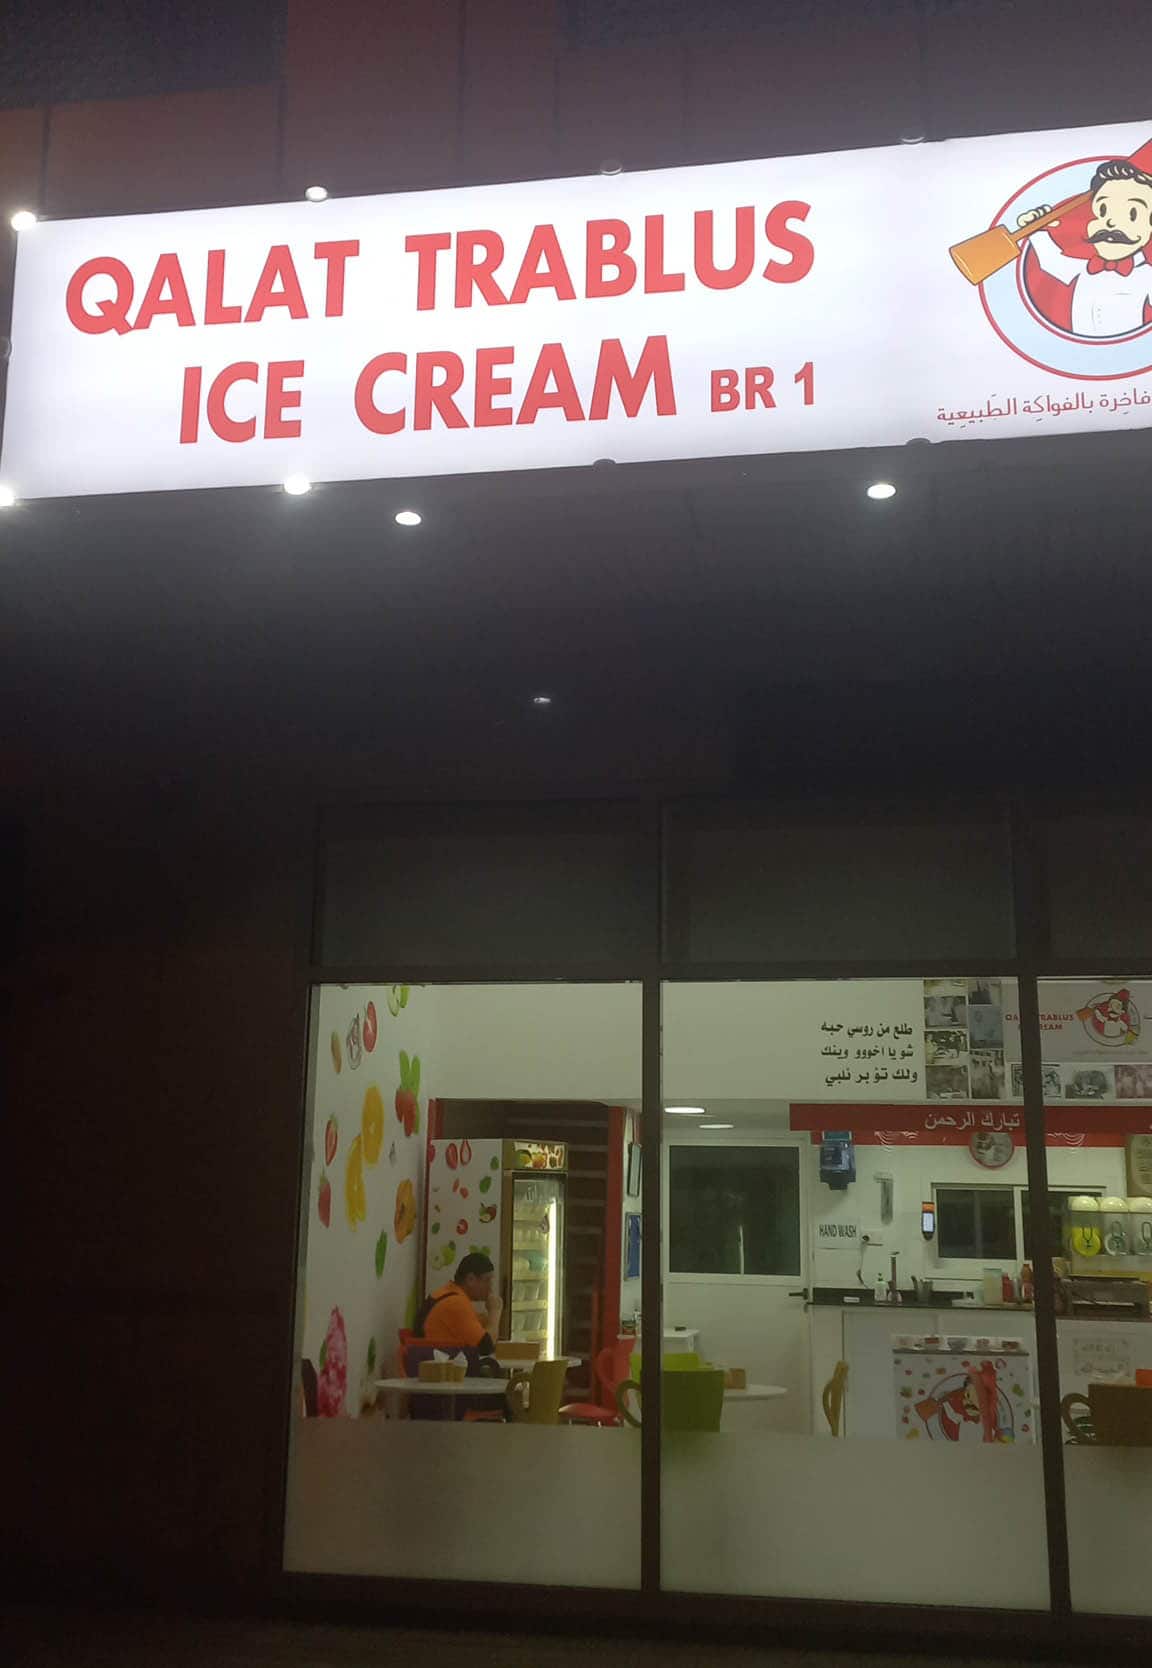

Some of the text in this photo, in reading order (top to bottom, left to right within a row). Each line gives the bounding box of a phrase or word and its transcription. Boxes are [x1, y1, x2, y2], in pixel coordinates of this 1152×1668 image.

[66, 200, 815, 335] QALAT TRABLUS
[179, 335, 814, 444] ICE CREAM BR 1
[847, 1024, 873, 1038] روسي
[876, 1023, 890, 1037] من
[893, 1023, 913, 1040] طلع
[821, 1044, 849, 1060] وينك
[899, 1043, 914, 1060] شو
[892, 1068, 918, 1083] ولك
[924, 1111, 1020, 1131] تبارك الرحمن
[819, 1224, 857, 1238] HAND WASH
